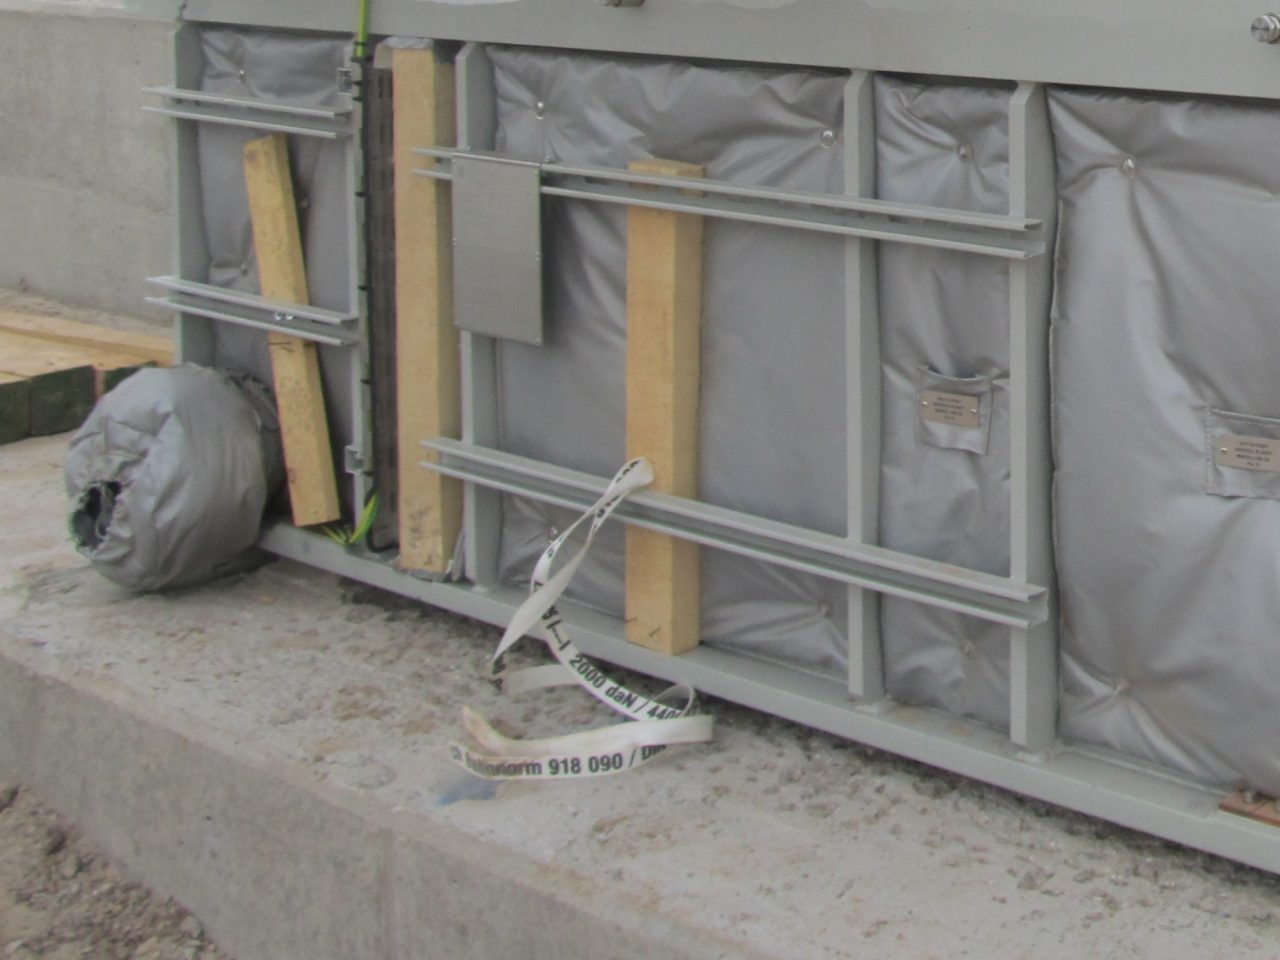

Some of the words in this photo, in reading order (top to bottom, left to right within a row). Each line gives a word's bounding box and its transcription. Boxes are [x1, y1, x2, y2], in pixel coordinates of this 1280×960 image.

[568, 654, 607, 689] 2000
[604, 685, 639, 709] daN
[547, 757, 582, 776] 918
[588, 752, 623, 773] 090
